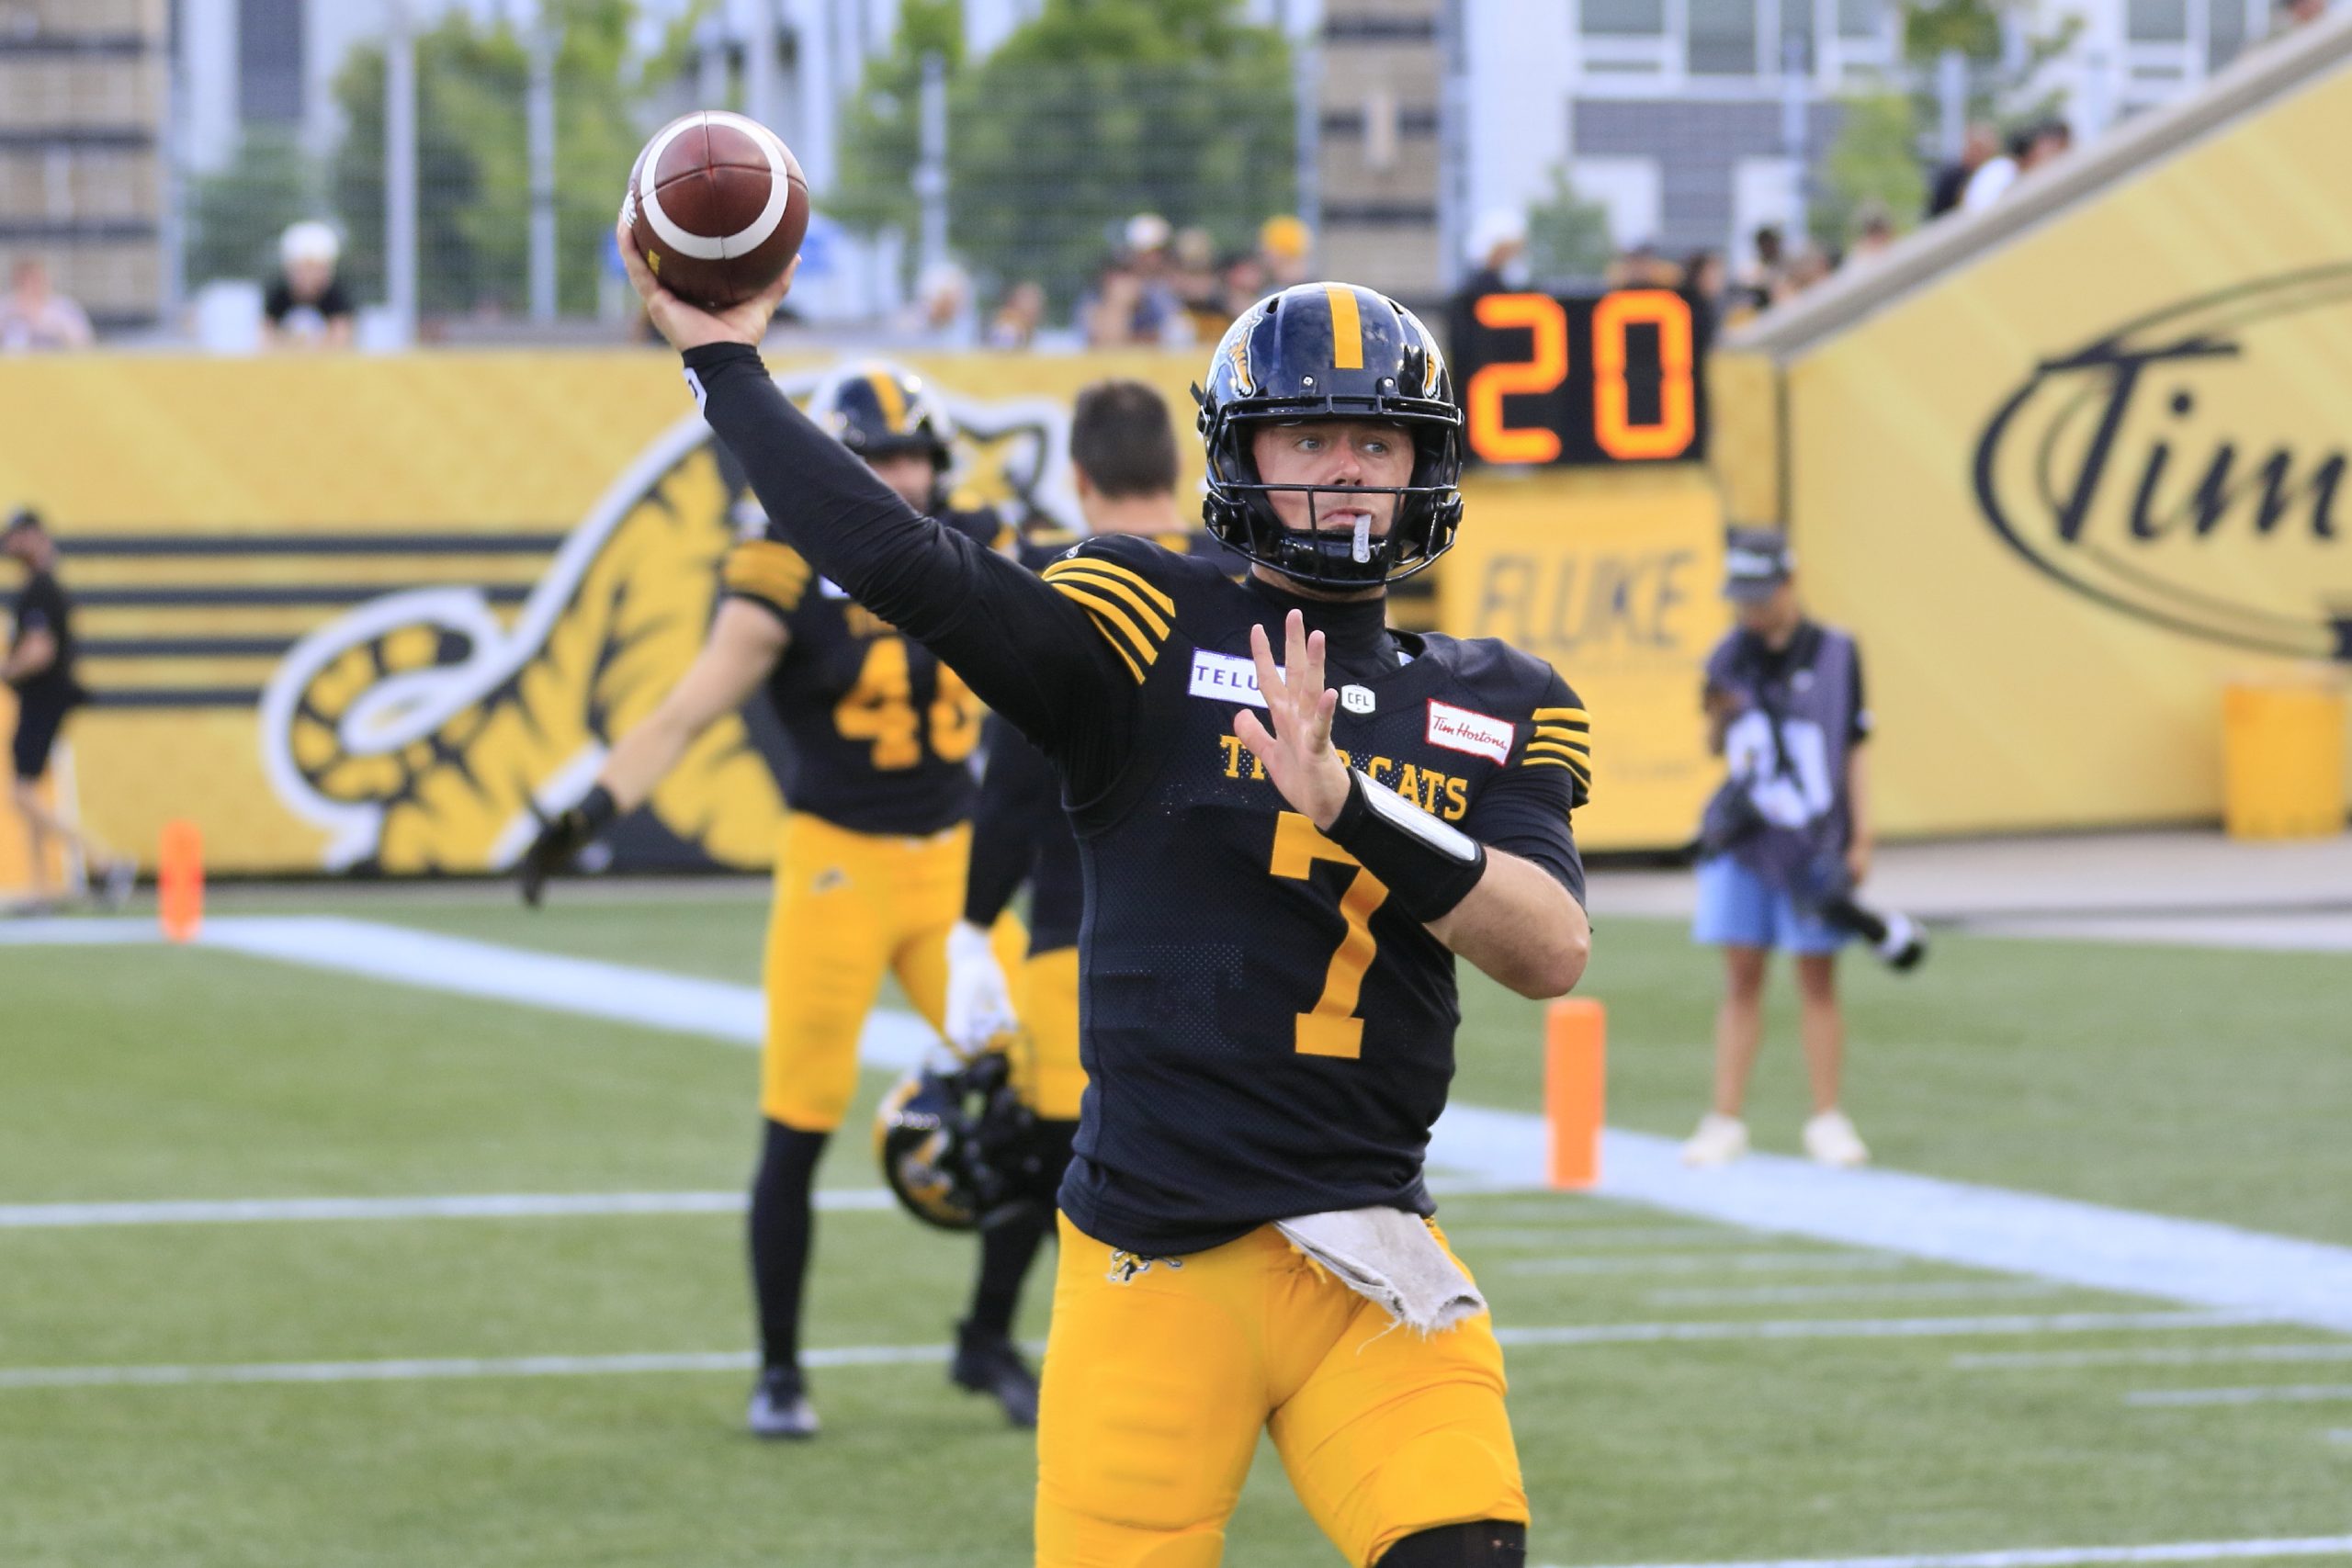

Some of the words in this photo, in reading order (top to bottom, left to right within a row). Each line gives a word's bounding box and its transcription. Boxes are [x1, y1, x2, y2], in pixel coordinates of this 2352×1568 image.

[1467, 289, 1695, 464] 20
[2037, 335, 2350, 544] Tim
[1195, 664, 1259, 691] TELU
[1347, 692, 1370, 706] CFL
[1433, 715, 1454, 735] Tim
[1270, 810, 1389, 1058] 7
